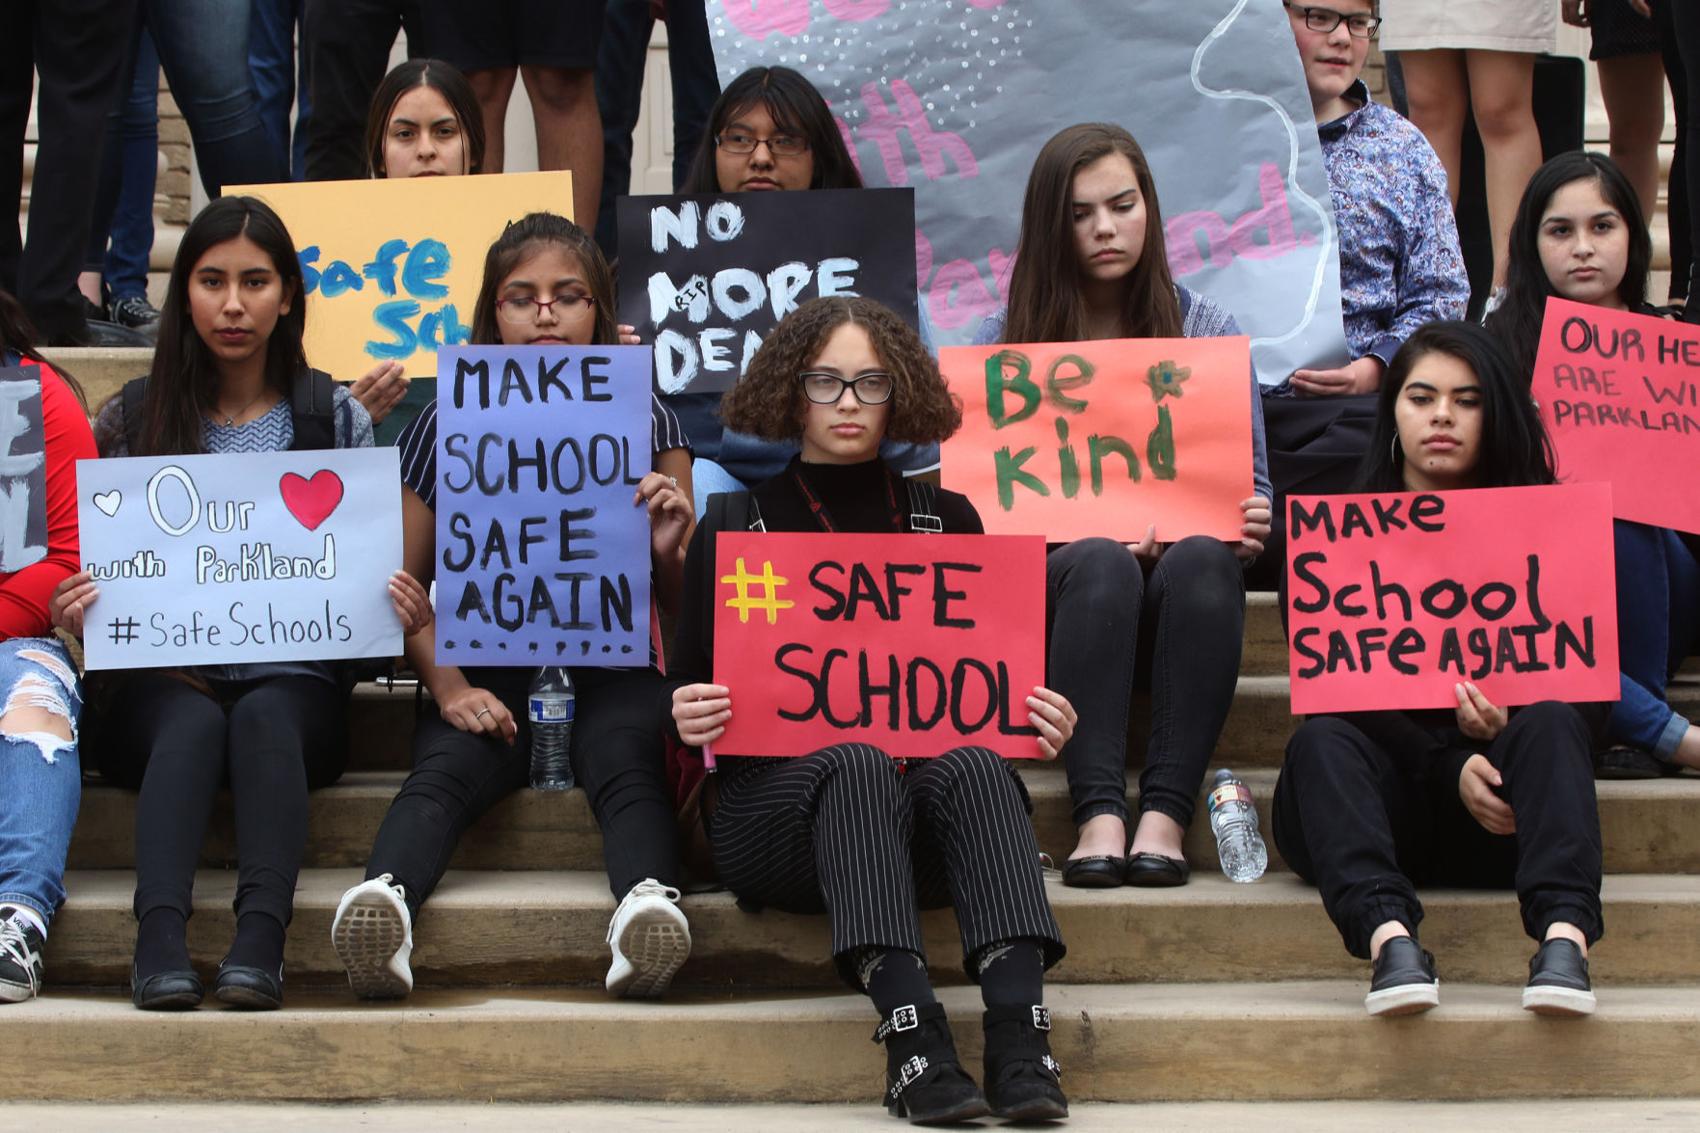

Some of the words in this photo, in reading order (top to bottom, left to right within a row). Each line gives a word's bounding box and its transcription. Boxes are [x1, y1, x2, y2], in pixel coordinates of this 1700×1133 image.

[651, 201, 746, 253] NO
[648, 257, 861, 330] MORE
[1561, 316, 1645, 363] OUR
[453, 356, 613, 411] MAKE
[1553, 363, 1622, 397] ARE
[444, 432, 645, 496] SCHOOL
[146, 464, 255, 537] Our
[87, 550, 166, 581] with
[443, 507, 600, 573] SAFE
[456, 572, 634, 632] AGAIN
[1293, 551, 1552, 632] School
[774, 643, 1042, 736] SCHOOL
